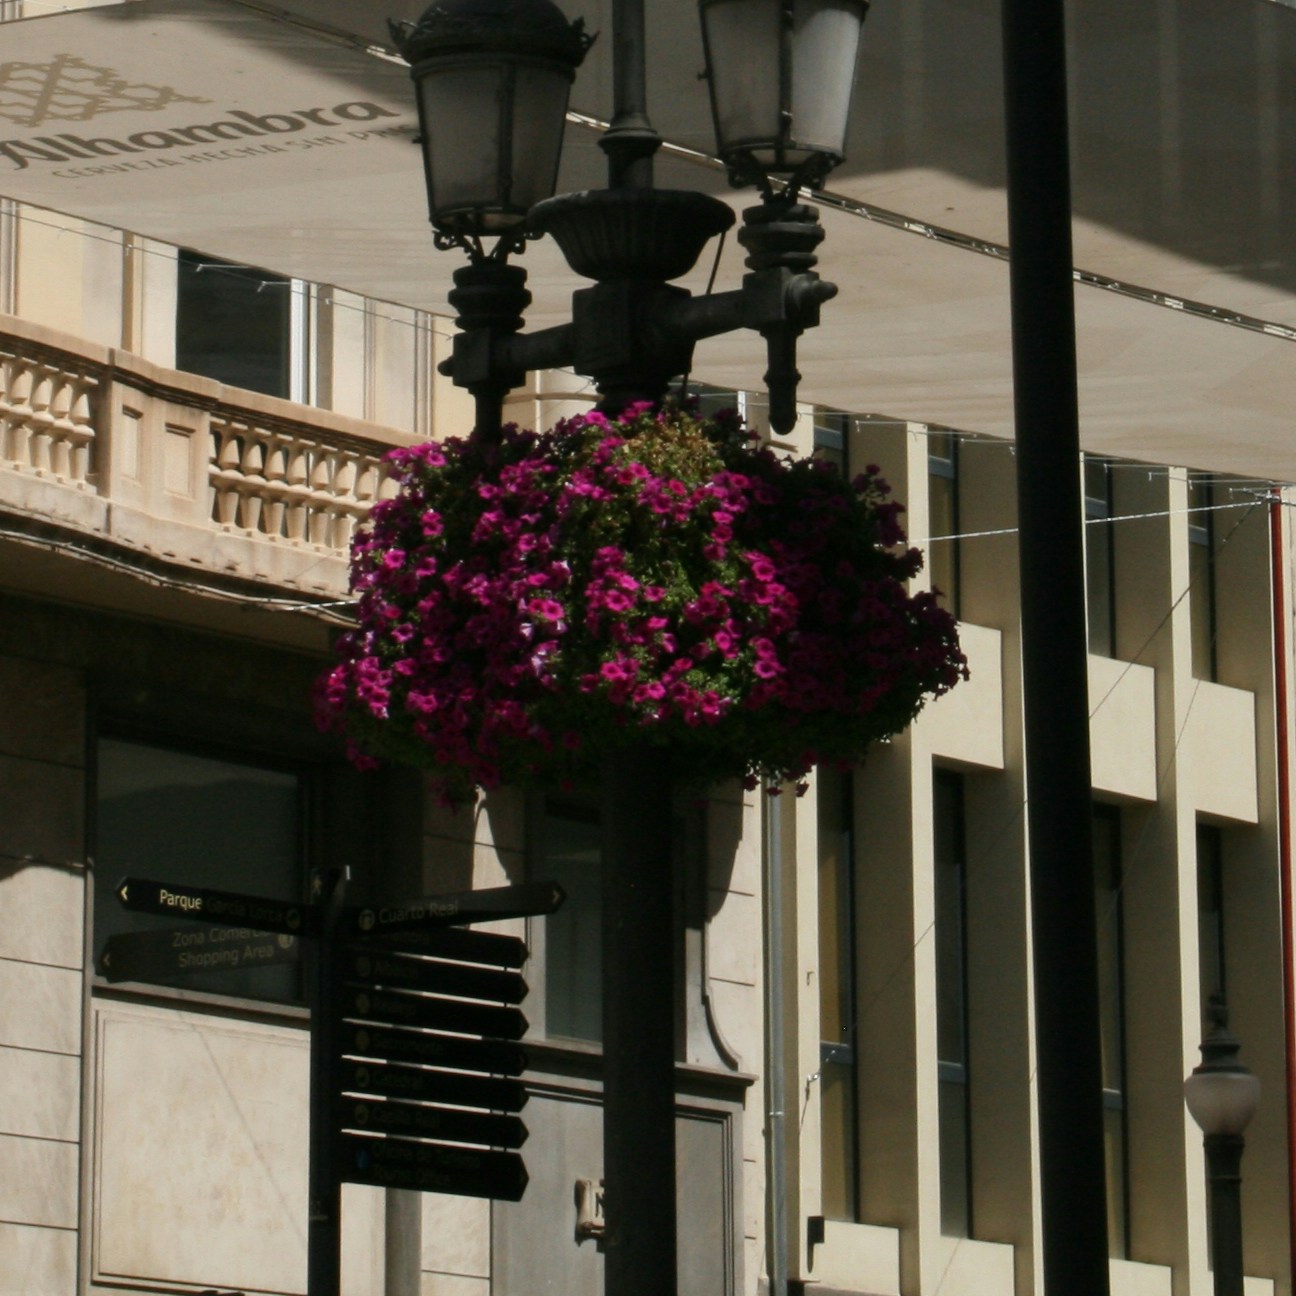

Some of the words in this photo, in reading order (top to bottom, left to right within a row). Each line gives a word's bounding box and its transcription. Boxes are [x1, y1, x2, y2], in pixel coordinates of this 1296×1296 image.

[52, 158, 182, 179] CERVEZA
[181, 145, 290, 164] HECHA
[284, 135, 347, 150] SIN
[159, 888, 202, 911] Parque
[378, 905, 425, 924] Cuarto
[429, 899, 459, 917] Real
[172, 932, 206, 948] Zona
[178, 949, 241, 969] Shopping
[245, 945, 276, 961] Area
